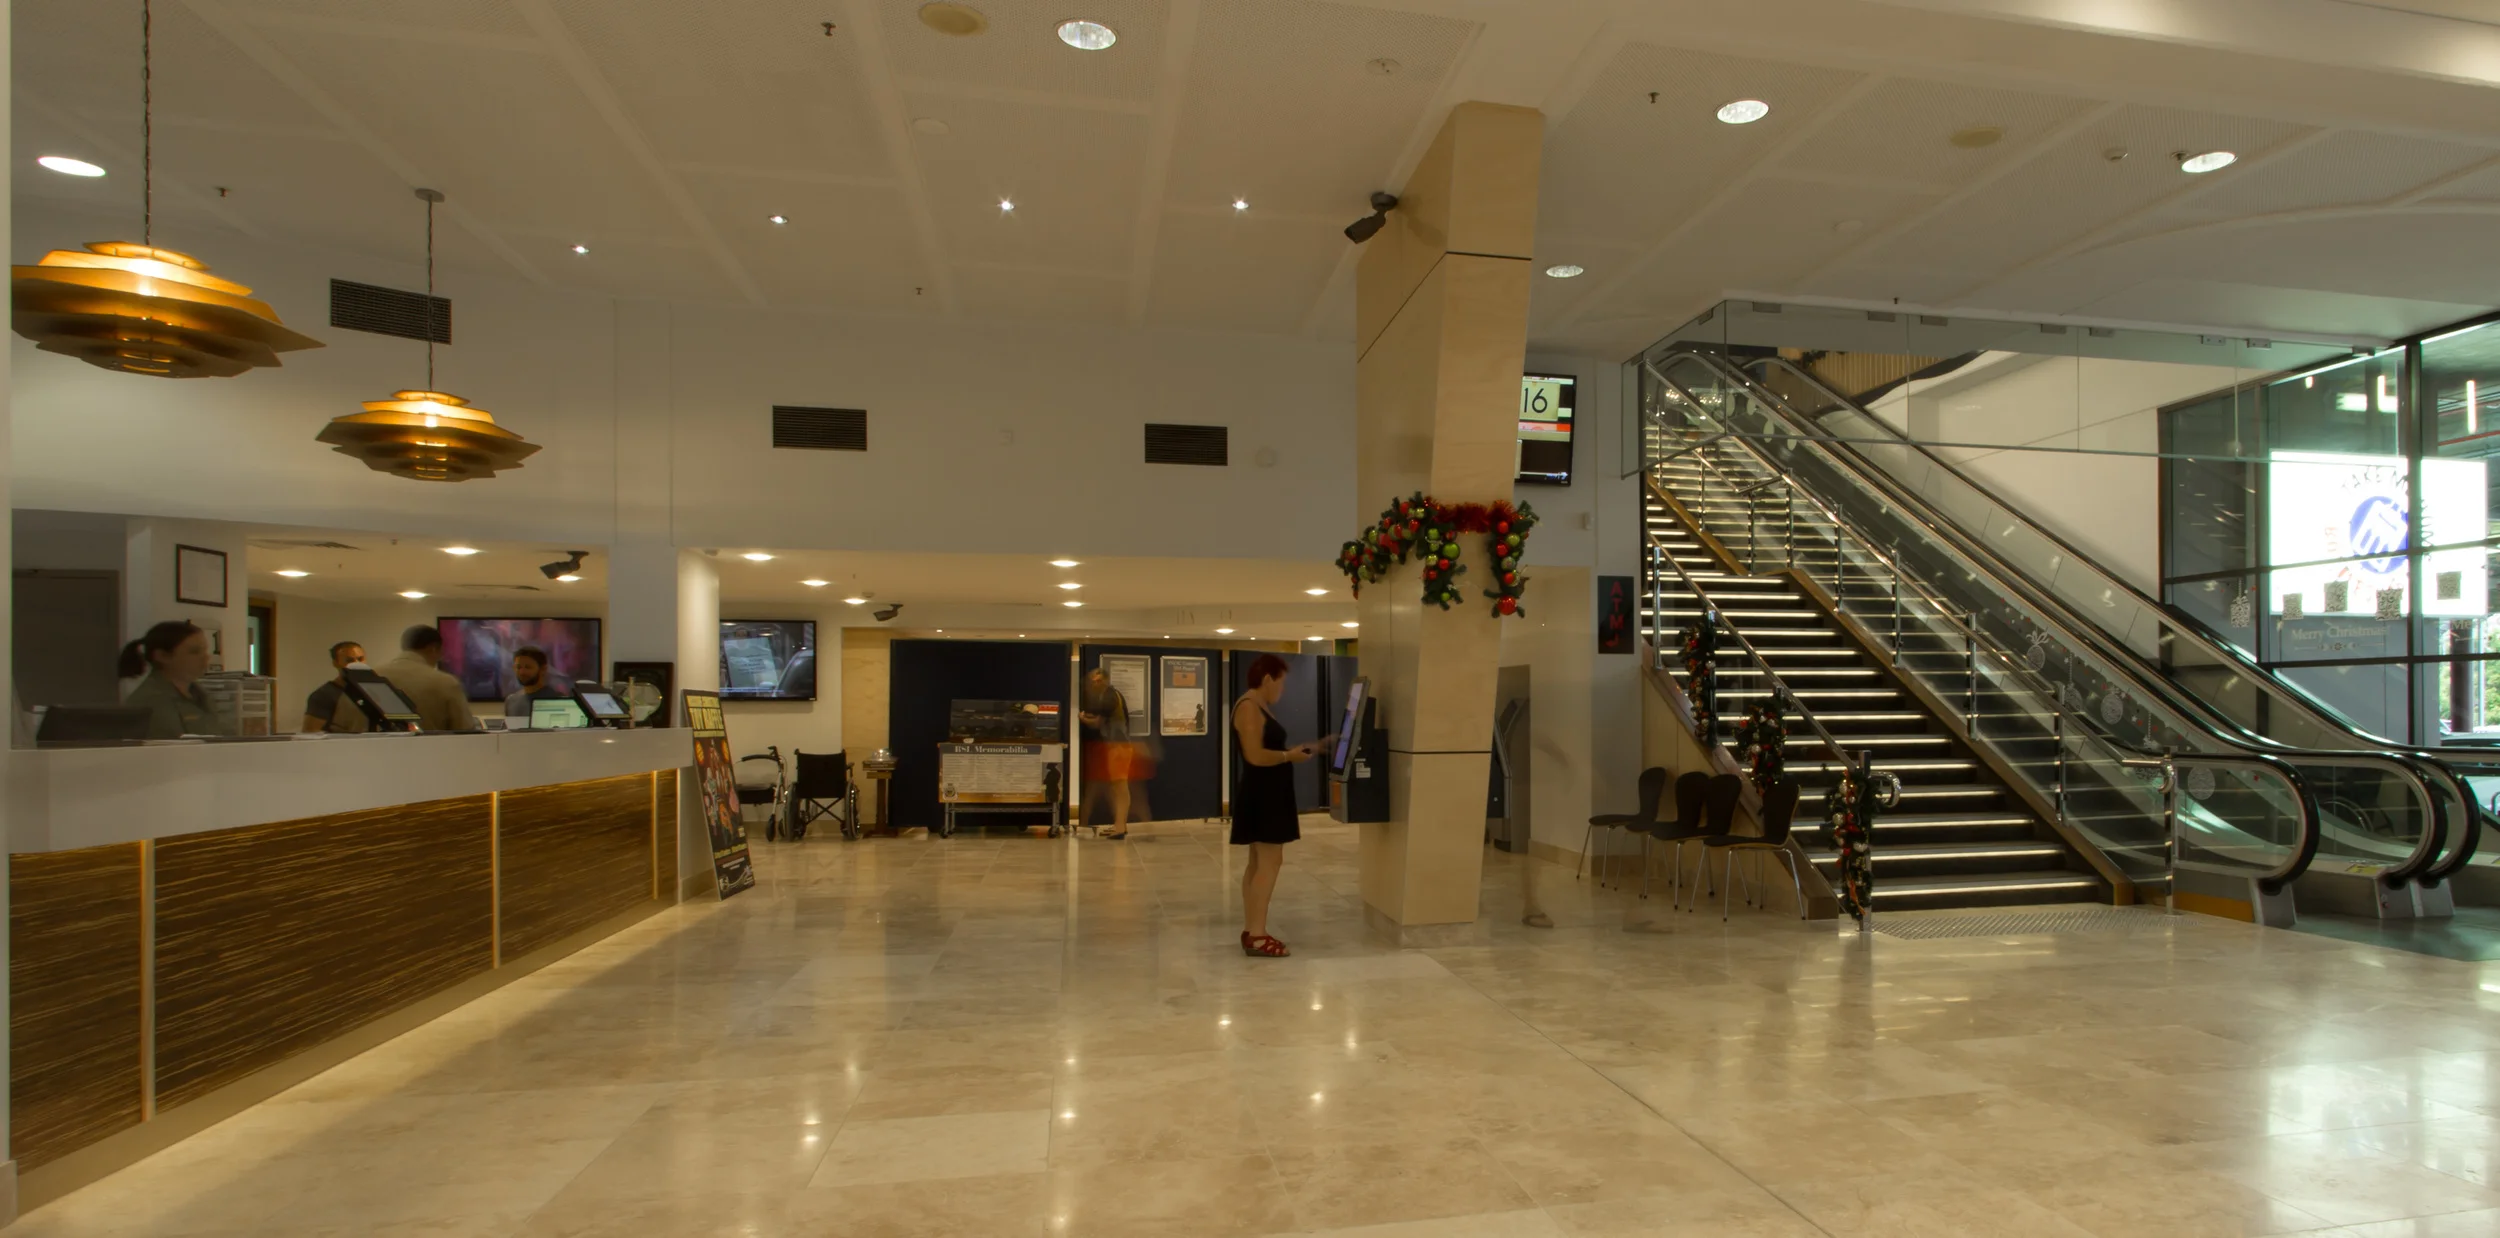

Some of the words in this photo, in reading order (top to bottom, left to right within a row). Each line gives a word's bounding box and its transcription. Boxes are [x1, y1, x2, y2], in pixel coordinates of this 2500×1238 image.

[1609, 580, 1625, 630] ATM
[2291, 627, 2324, 644] Merry
[954, 745, 973, 754] RSL
[975, 745, 1028, 754] Memorabilia
